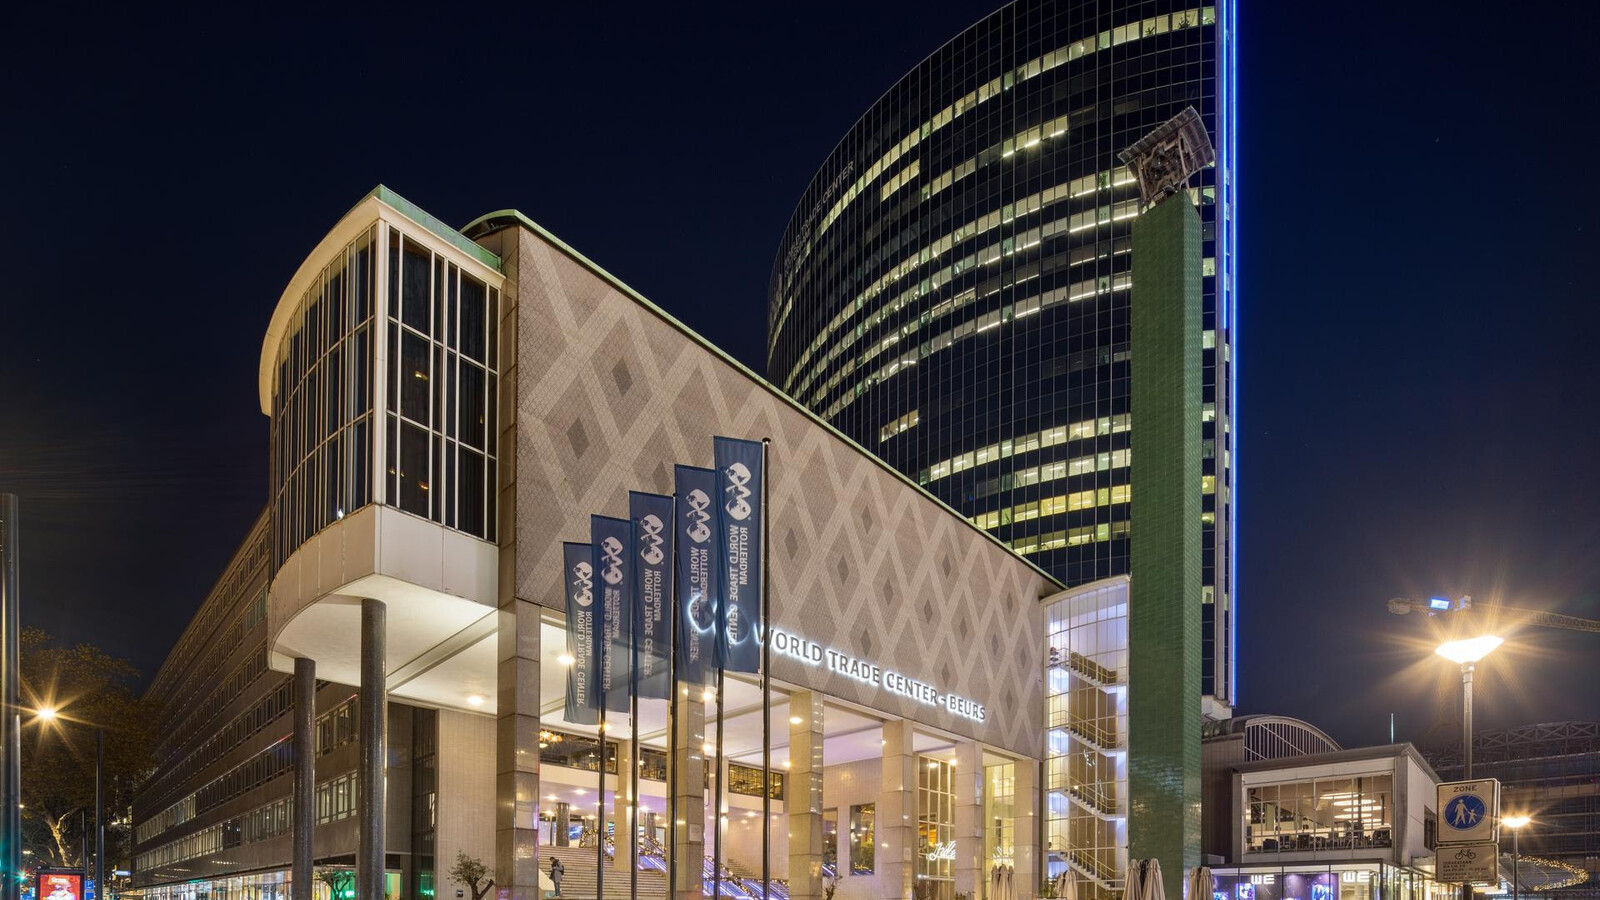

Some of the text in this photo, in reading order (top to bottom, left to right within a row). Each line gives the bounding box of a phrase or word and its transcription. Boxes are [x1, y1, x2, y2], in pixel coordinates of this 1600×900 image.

[822, 161, 854, 204] CENTER
[828, 650, 880, 684] TRADE
[886, 672, 938, 705] CENTER
[949, 695, 986, 720] BEURS
[1251, 874, 1275, 885] WE
[1343, 871, 1370, 883] WE
